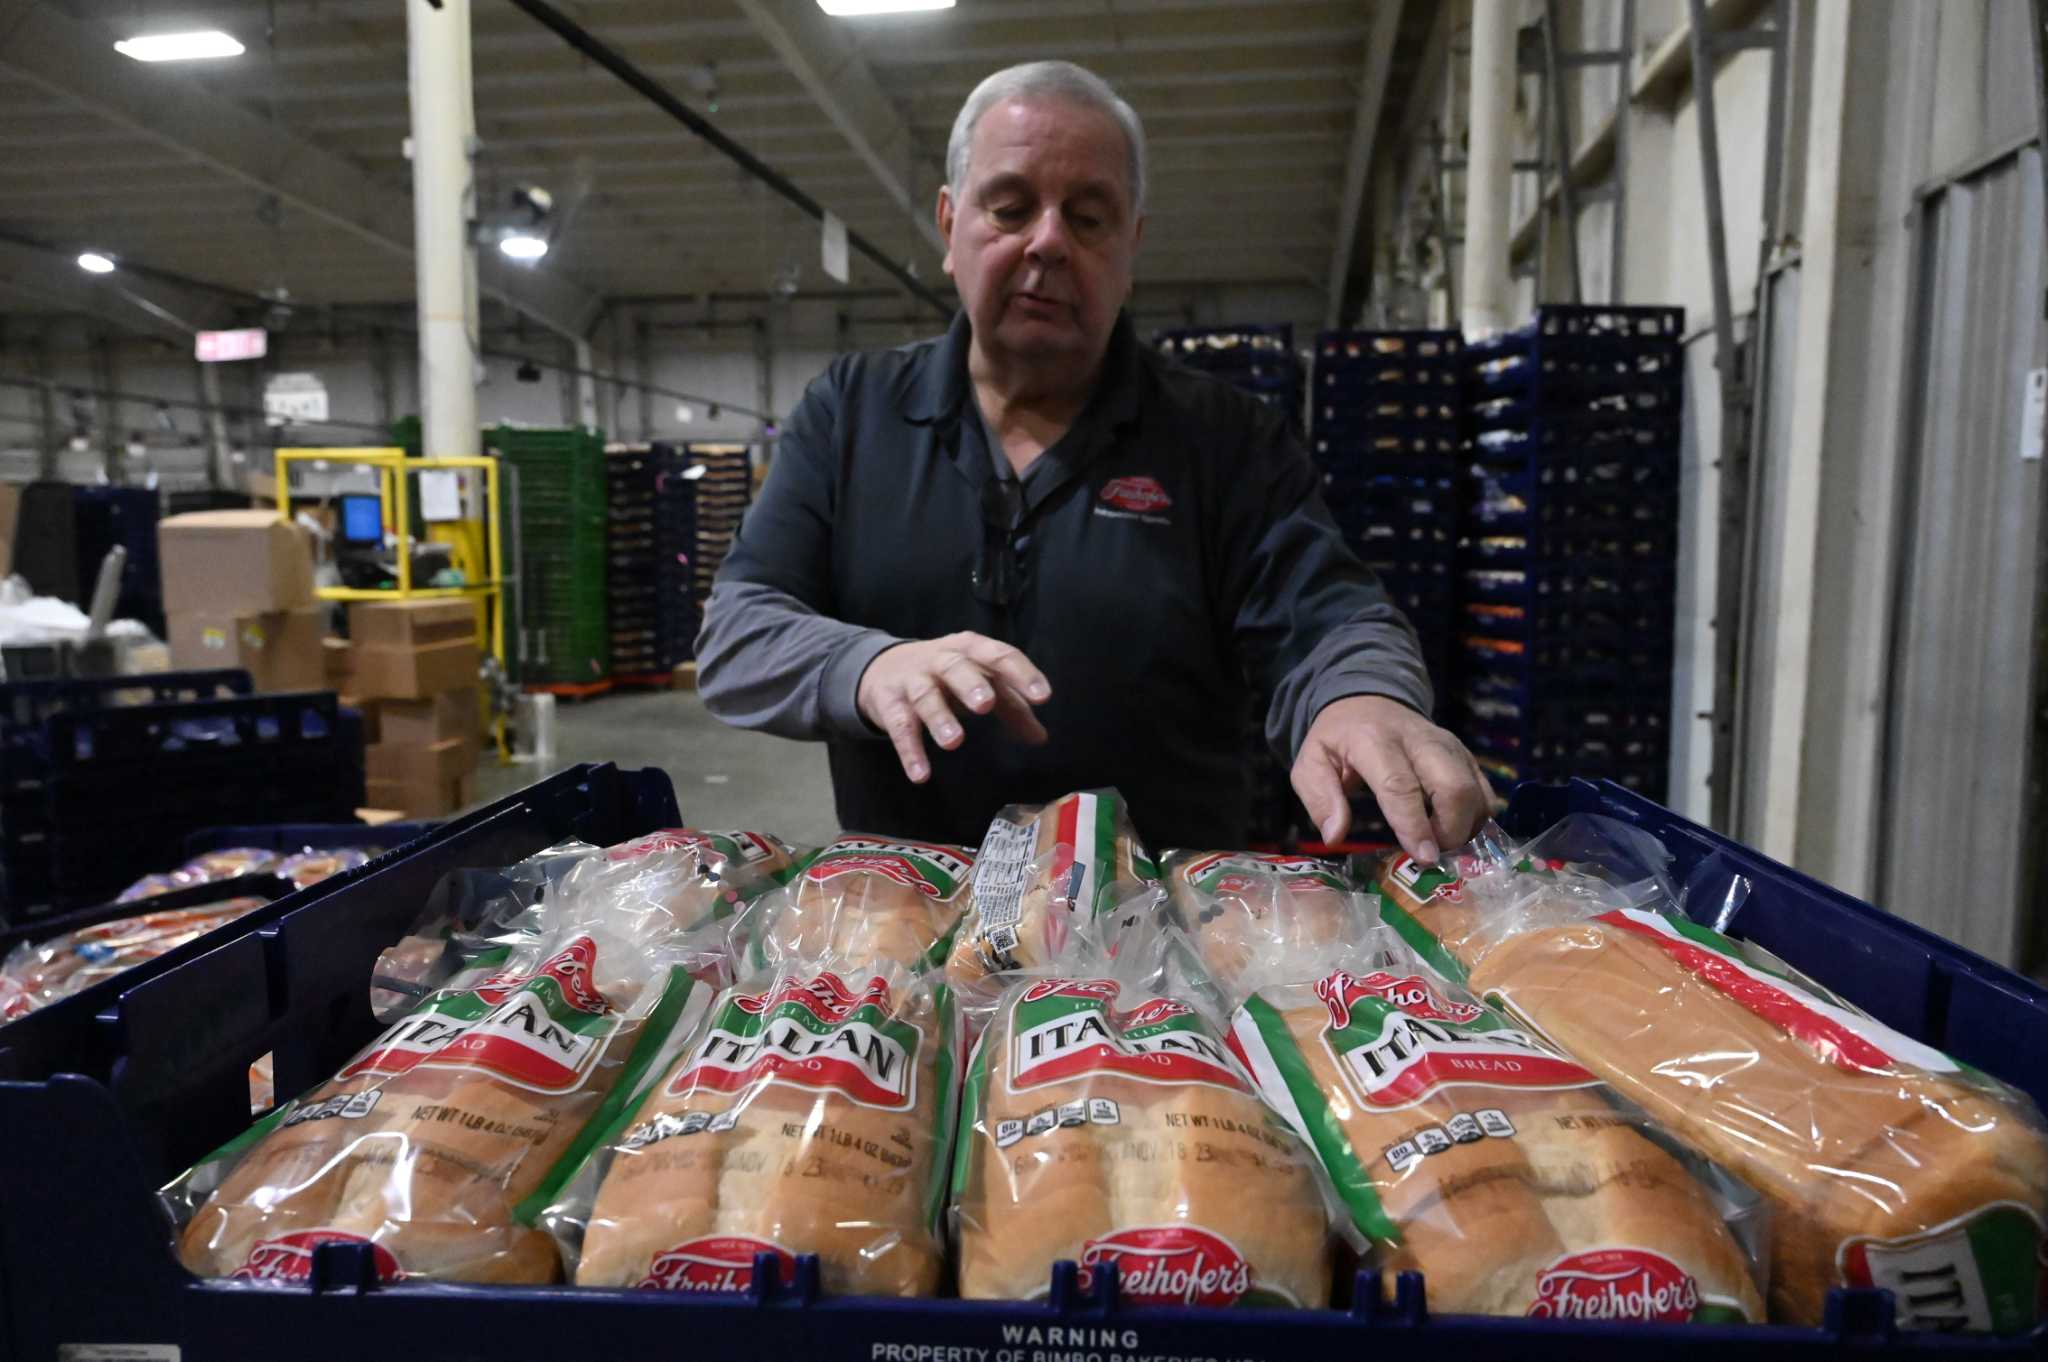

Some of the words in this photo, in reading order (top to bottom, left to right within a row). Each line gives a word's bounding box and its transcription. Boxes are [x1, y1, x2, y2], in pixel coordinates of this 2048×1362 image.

[381, 1003, 577, 1054] ITAAN
[1029, 1015, 1228, 1065] ITAIAN
[1449, 1057, 1523, 1073] BREAD
[1165, 1113, 1188, 1128] NET
[1191, 1114, 1209, 1128] WT
[1083, 1243, 1249, 1305] eihofer's
[1528, 1264, 1699, 1321] Freihofer's
[872, 1342, 990, 1362] PROPERTY
[995, 1349, 1025, 1362] OF
[1002, 1325, 1140, 1349] WARNING
